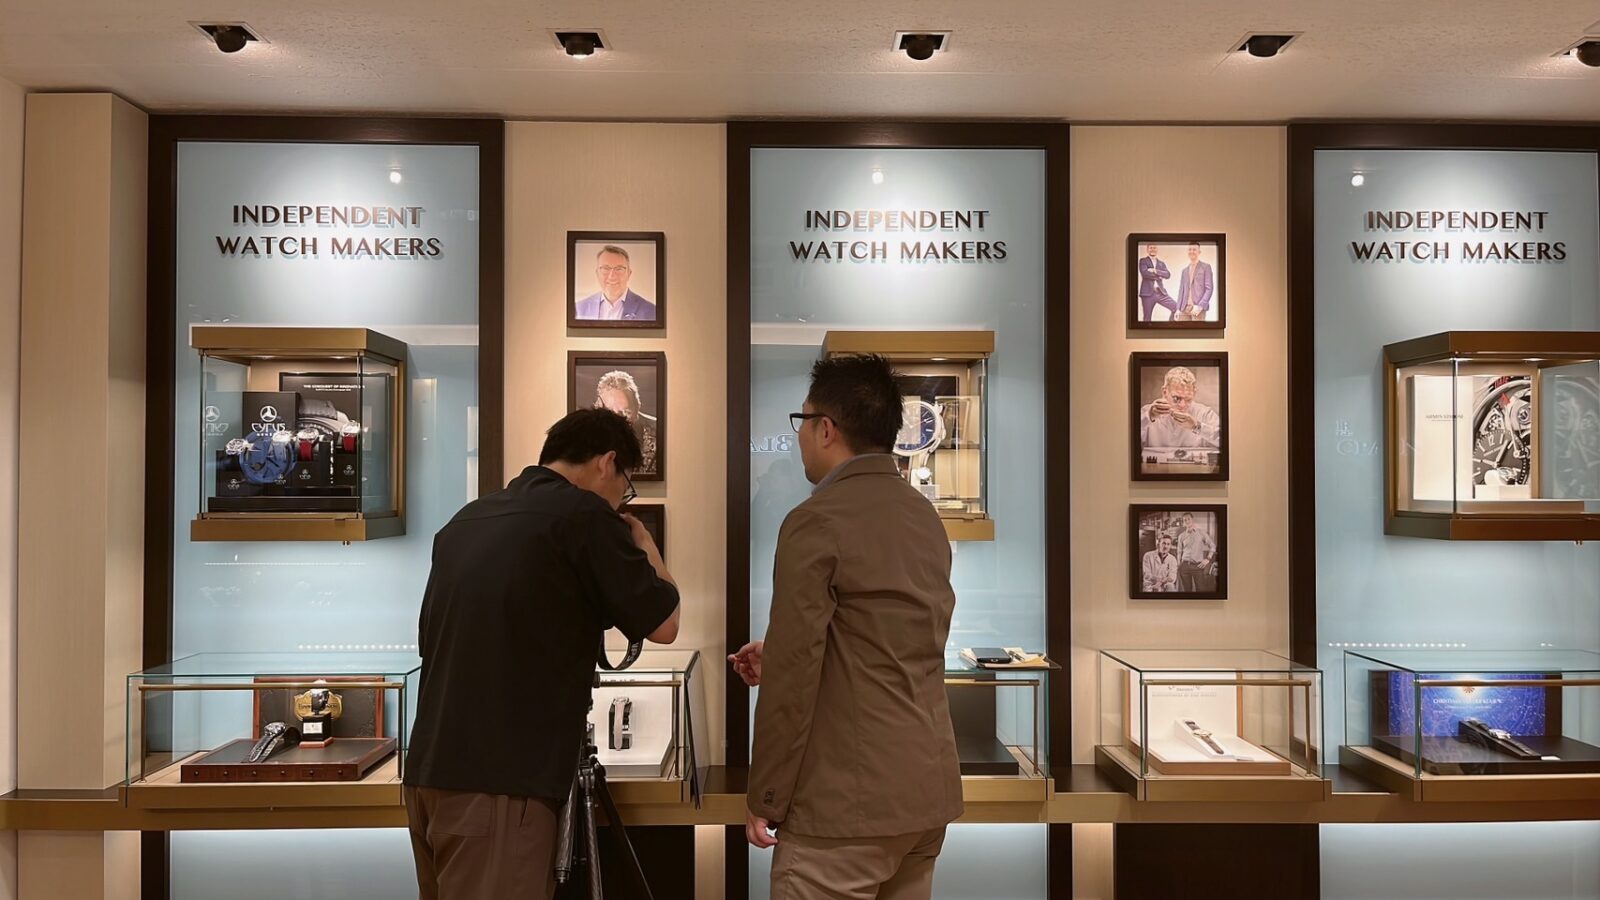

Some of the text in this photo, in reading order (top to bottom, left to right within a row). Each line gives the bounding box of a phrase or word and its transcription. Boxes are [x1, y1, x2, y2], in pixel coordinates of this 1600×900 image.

[233, 205, 423, 225] INDEPENDENT
[806, 210, 990, 229] INDEPENDENT
[1367, 210, 1549, 229] INDEPENDENT
[215, 236, 441, 256] WATCH MAKERS
[789, 241, 1008, 260] WATCH MAKERS
[1351, 241, 1567, 260] WATCH MAKERS
